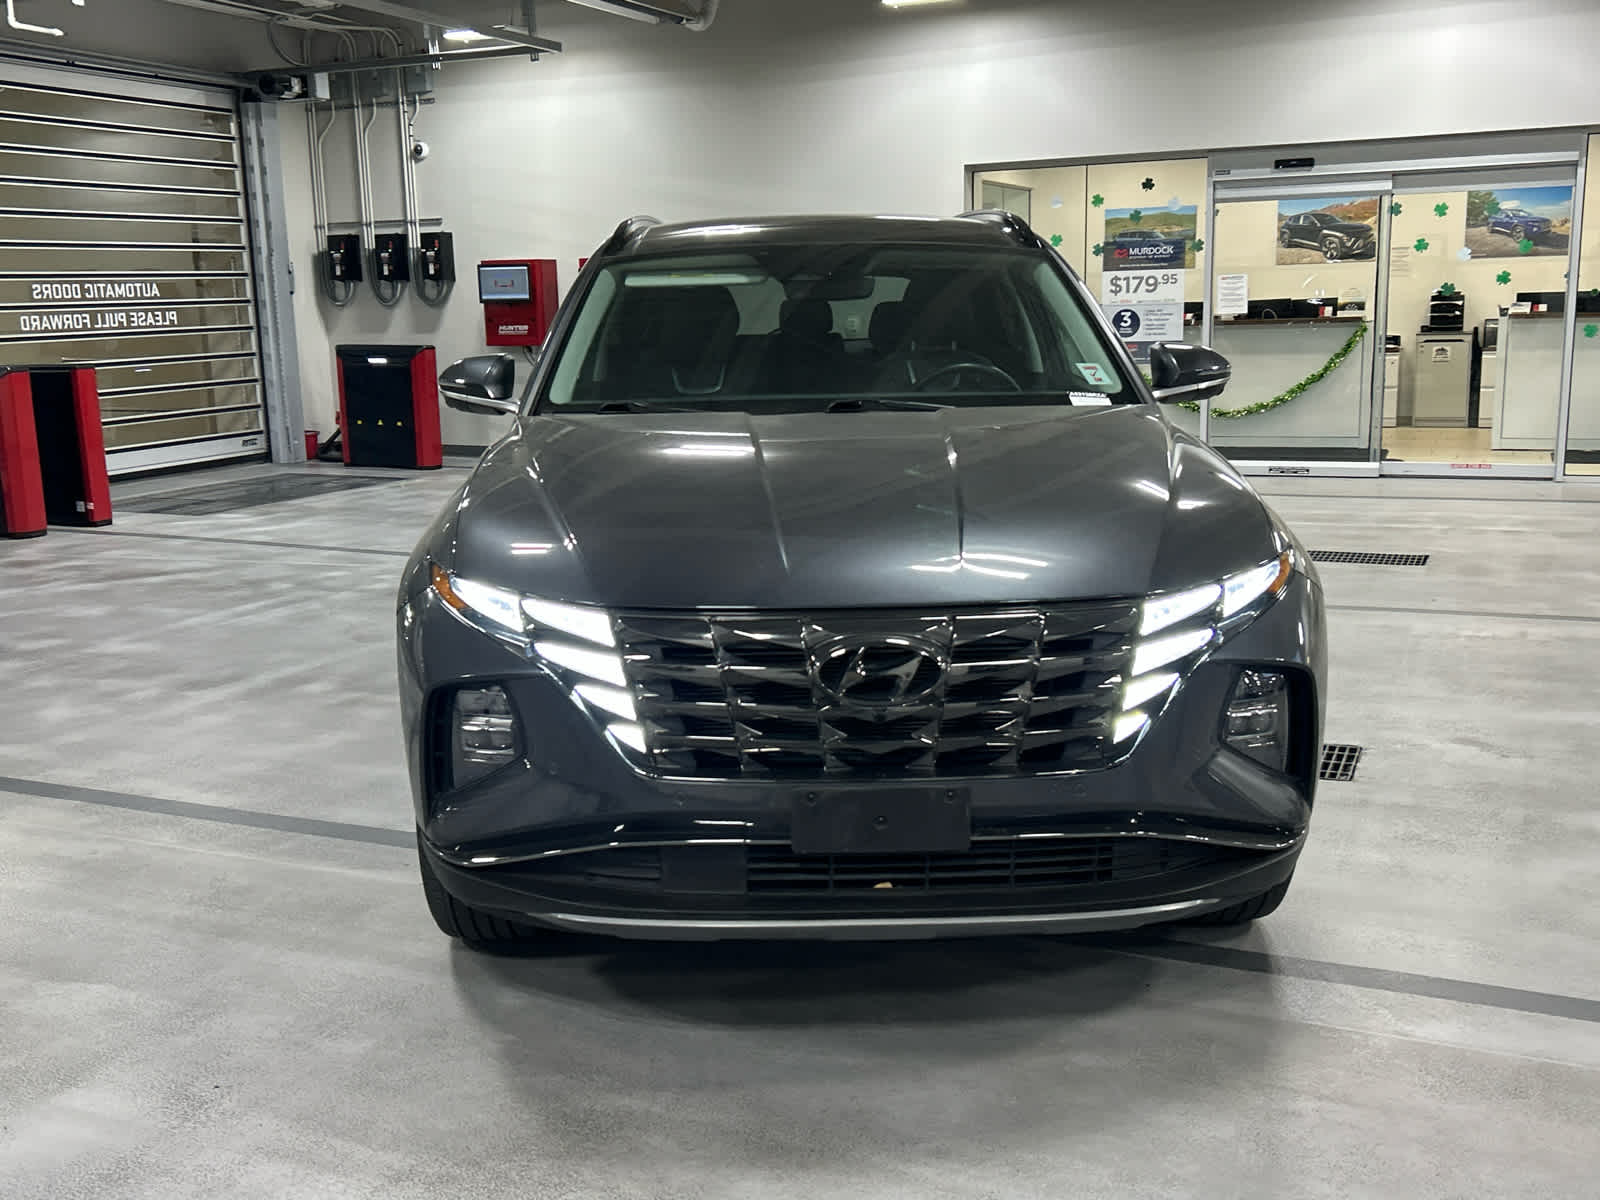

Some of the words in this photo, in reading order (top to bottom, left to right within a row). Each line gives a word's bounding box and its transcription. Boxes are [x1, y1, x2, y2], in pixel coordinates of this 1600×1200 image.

[1129, 245, 1174, 255] MURDOCK
[1109, 273, 1178, 296] $179.95
[1119, 311, 1132, 327] 3
